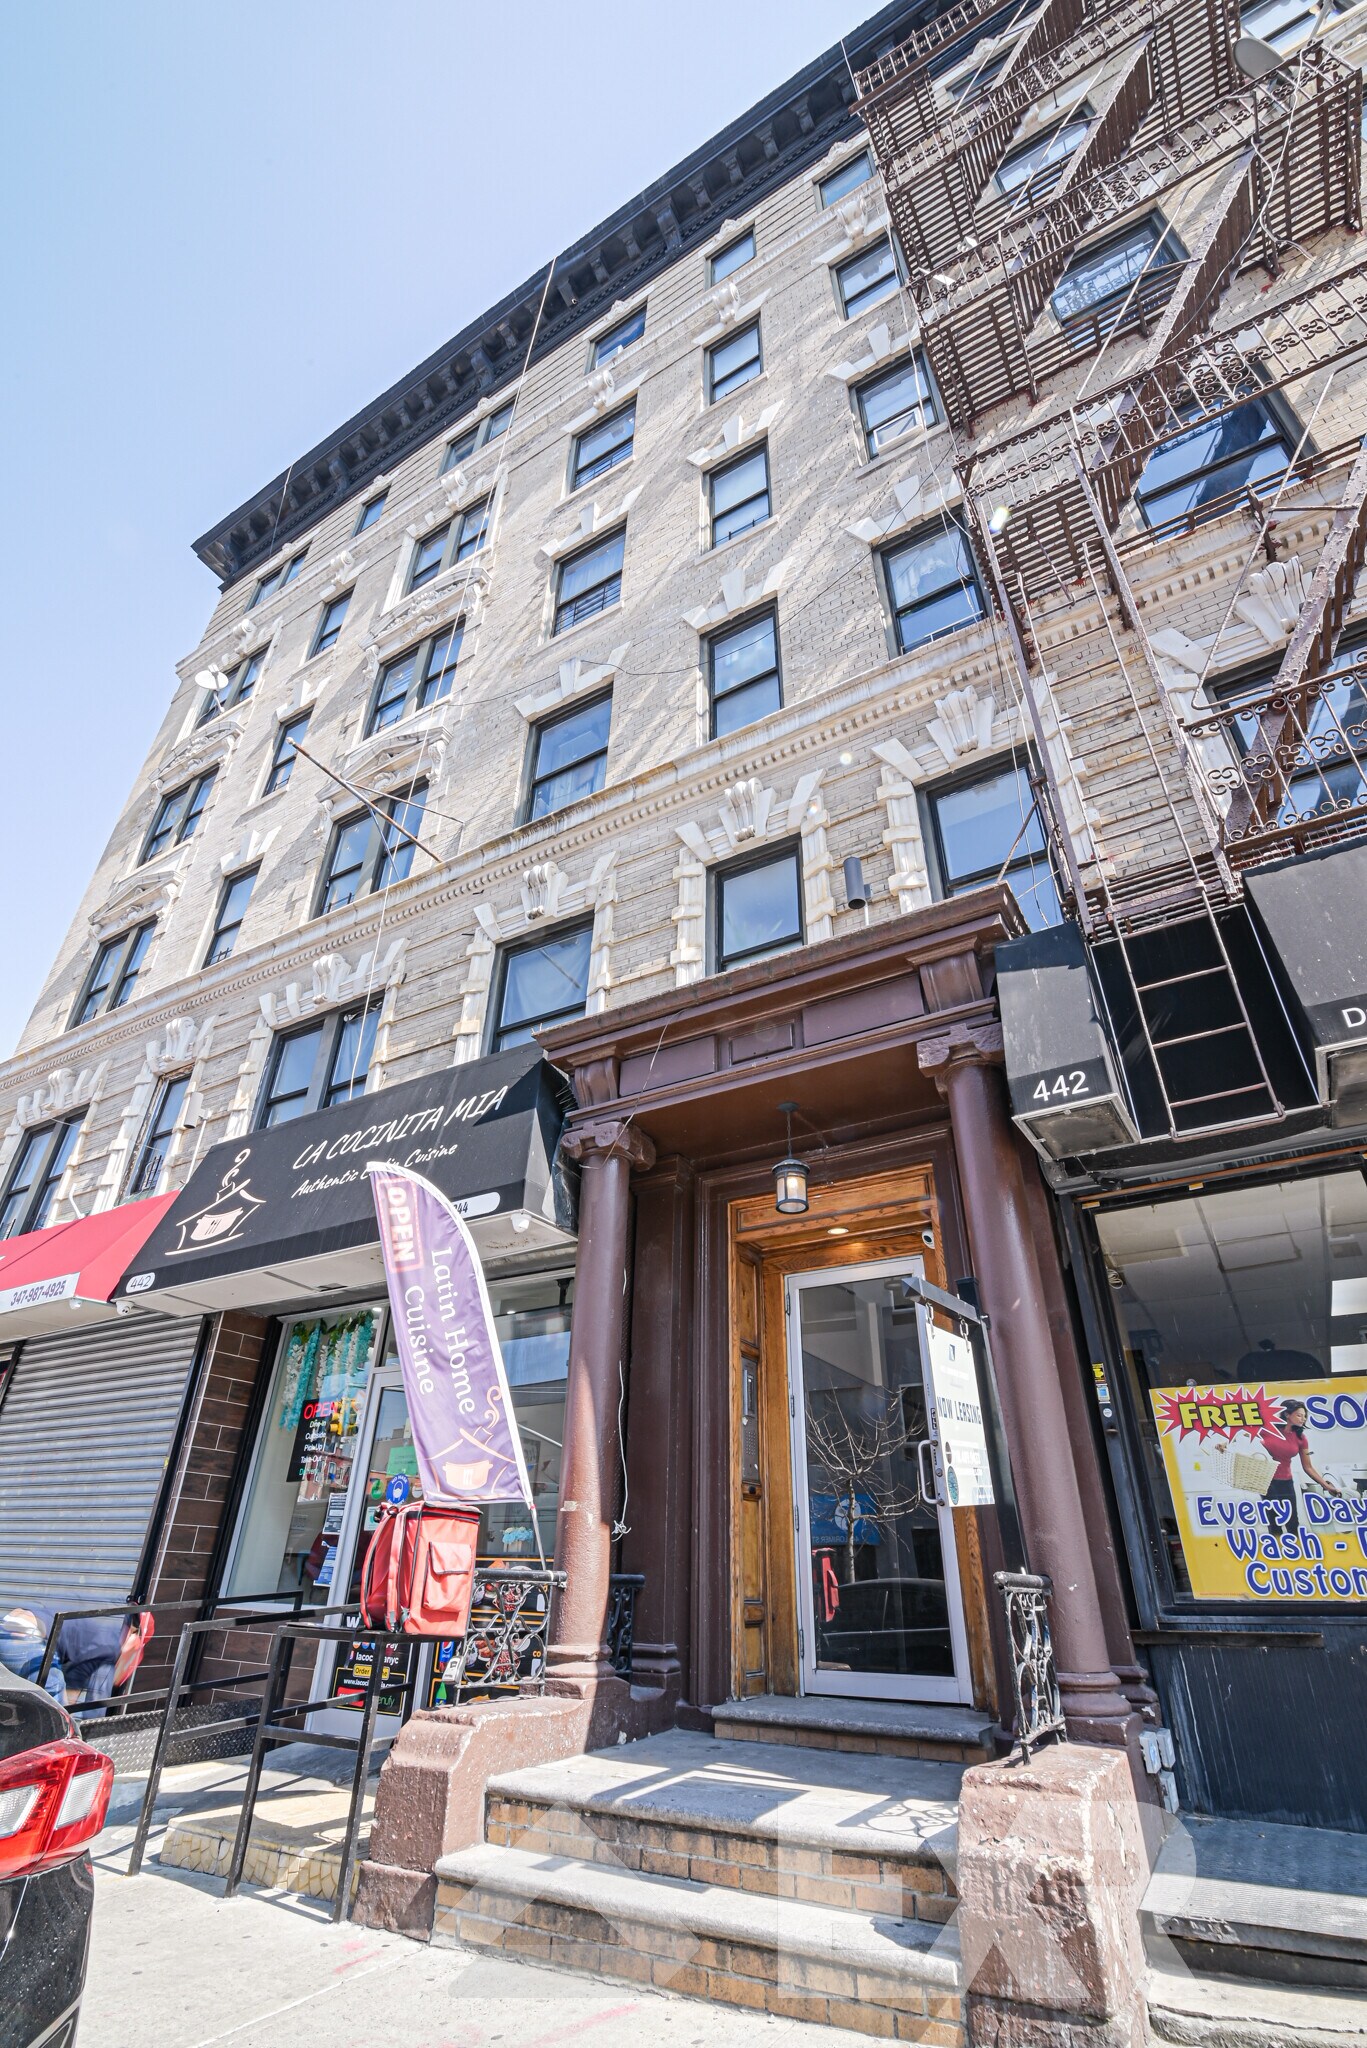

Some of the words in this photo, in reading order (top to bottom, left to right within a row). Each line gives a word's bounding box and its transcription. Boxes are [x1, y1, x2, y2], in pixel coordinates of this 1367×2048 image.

[1342, 1007, 1367, 1028] D
[1032, 1070, 1089, 1102] 442
[292, 1140, 328, 1170] LA
[325, 1105, 445, 1160] COCINITA
[444, 1085, 509, 1127] MIA
[291, 1169, 358, 1198] Authentic
[403, 1143, 458, 1168] Cuisine
[386, 1186, 416, 1262] OPEN
[10, 1279, 67, 1307] 347-987-4925
[130, 1275, 152, 1289] 442
[431, 1246, 459, 1323] Latin
[404, 1284, 435, 1396] Cuisine
[444, 1326, 476, 1415] Home
[303, 1401, 338, 1419] OPEN
[936, 1396, 954, 1419] NOW
[954, 1400, 982, 1425] LEASING
[1178, 1402, 1265, 1429] FREE
[1306, 1394, 1367, 1430] SO
[1197, 1494, 1291, 1527] Every
[1226, 1526, 1324, 1561] Wash
